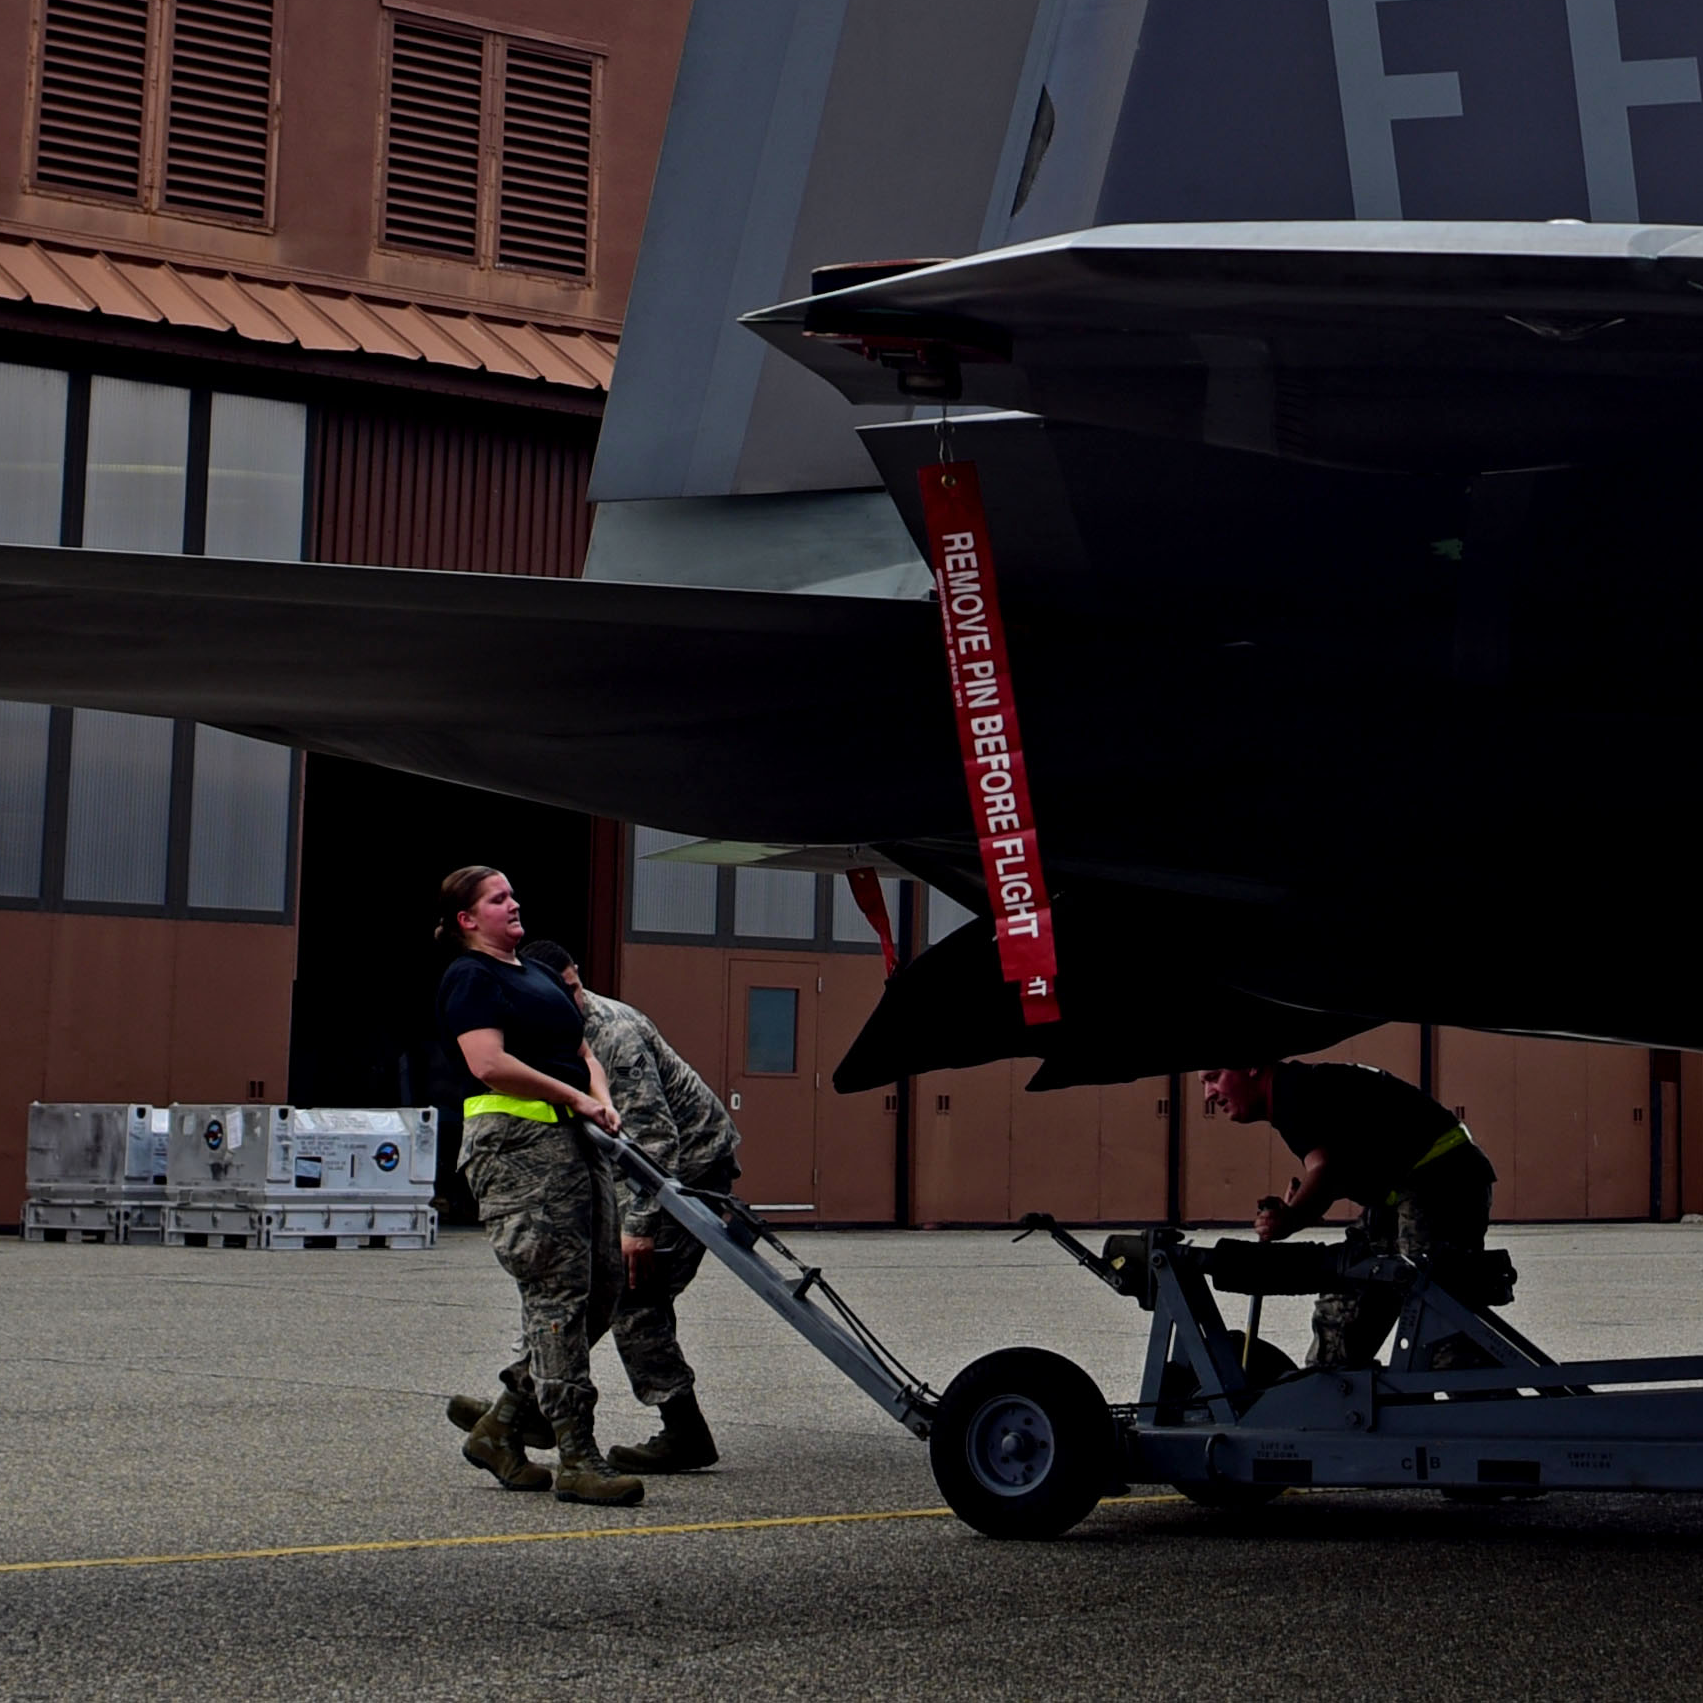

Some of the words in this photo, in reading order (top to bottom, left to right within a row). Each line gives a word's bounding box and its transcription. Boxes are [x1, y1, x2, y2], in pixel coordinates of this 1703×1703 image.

[942, 531, 991, 655] REMOVE
[962, 660, 1000, 708] PIN
[970, 714, 1020, 833] BEFORE
[992, 837, 1039, 939] FLIGHT
